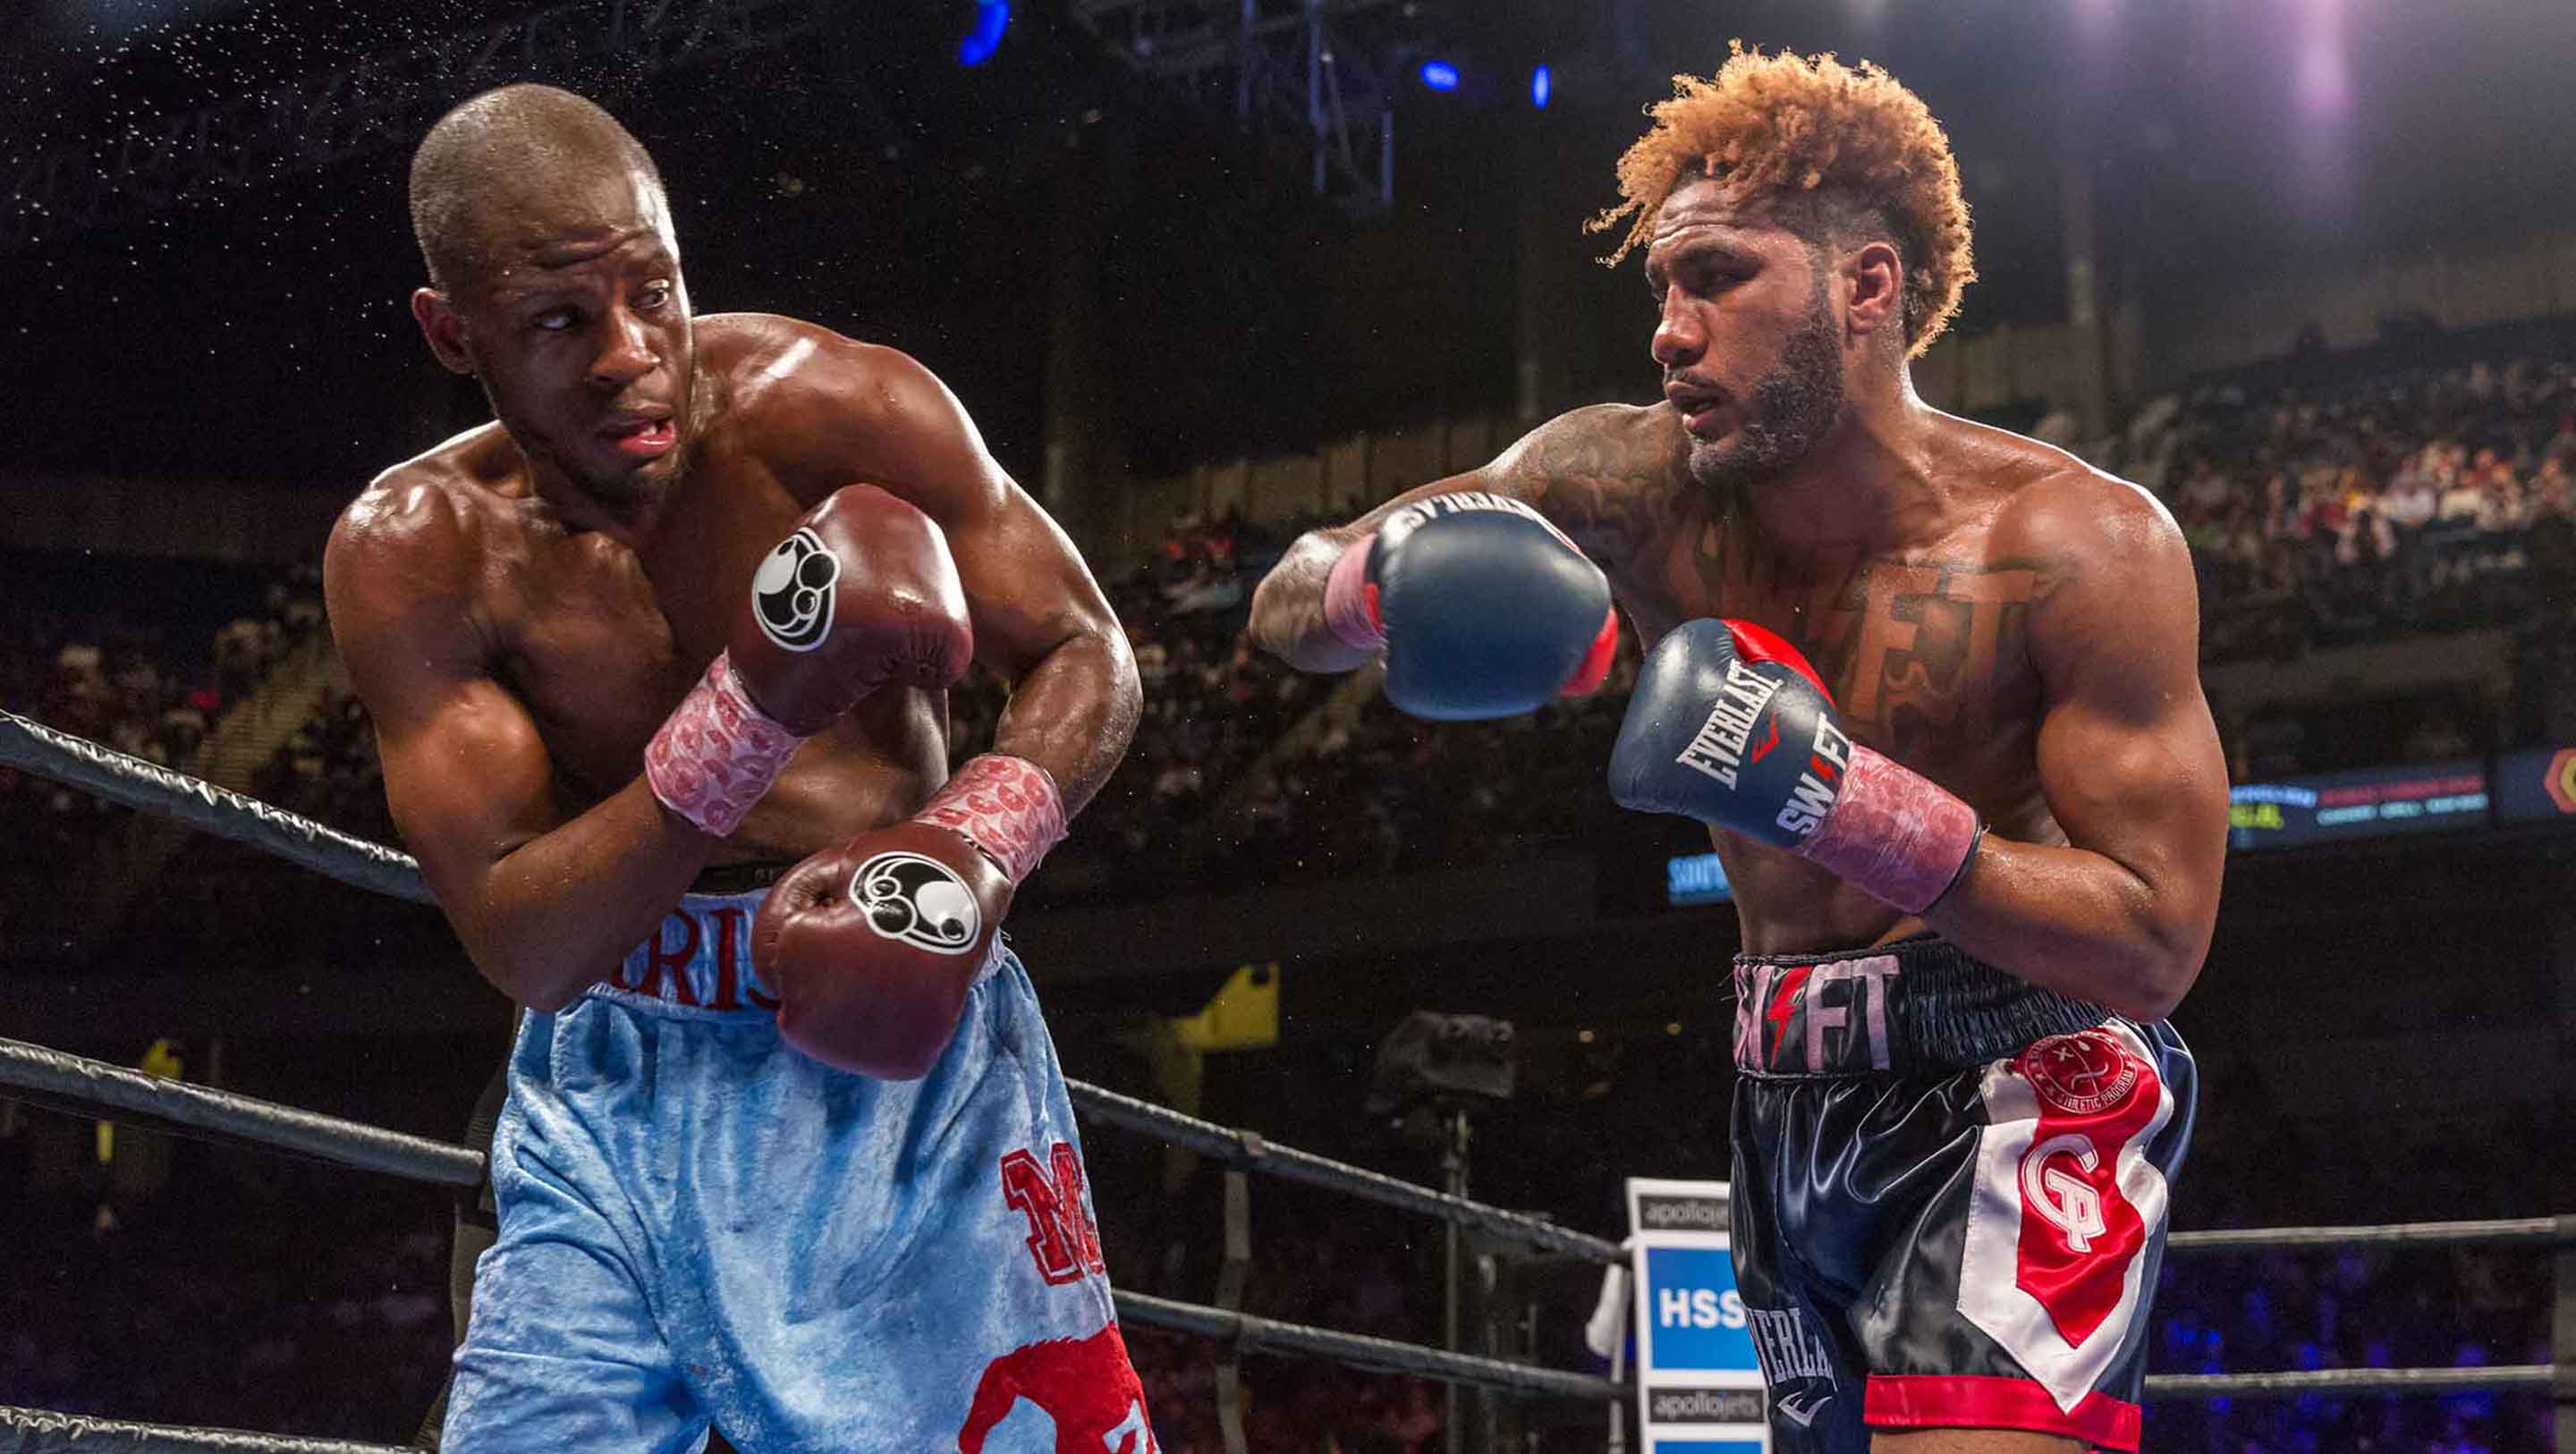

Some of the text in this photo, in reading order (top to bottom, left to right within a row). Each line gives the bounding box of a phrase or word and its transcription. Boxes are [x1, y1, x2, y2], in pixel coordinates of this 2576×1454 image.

[1675, 658, 1784, 791] EVERLAST
[1659, 1288, 1748, 1329] HSS
[1654, 1391, 1760, 1422] apollojets
